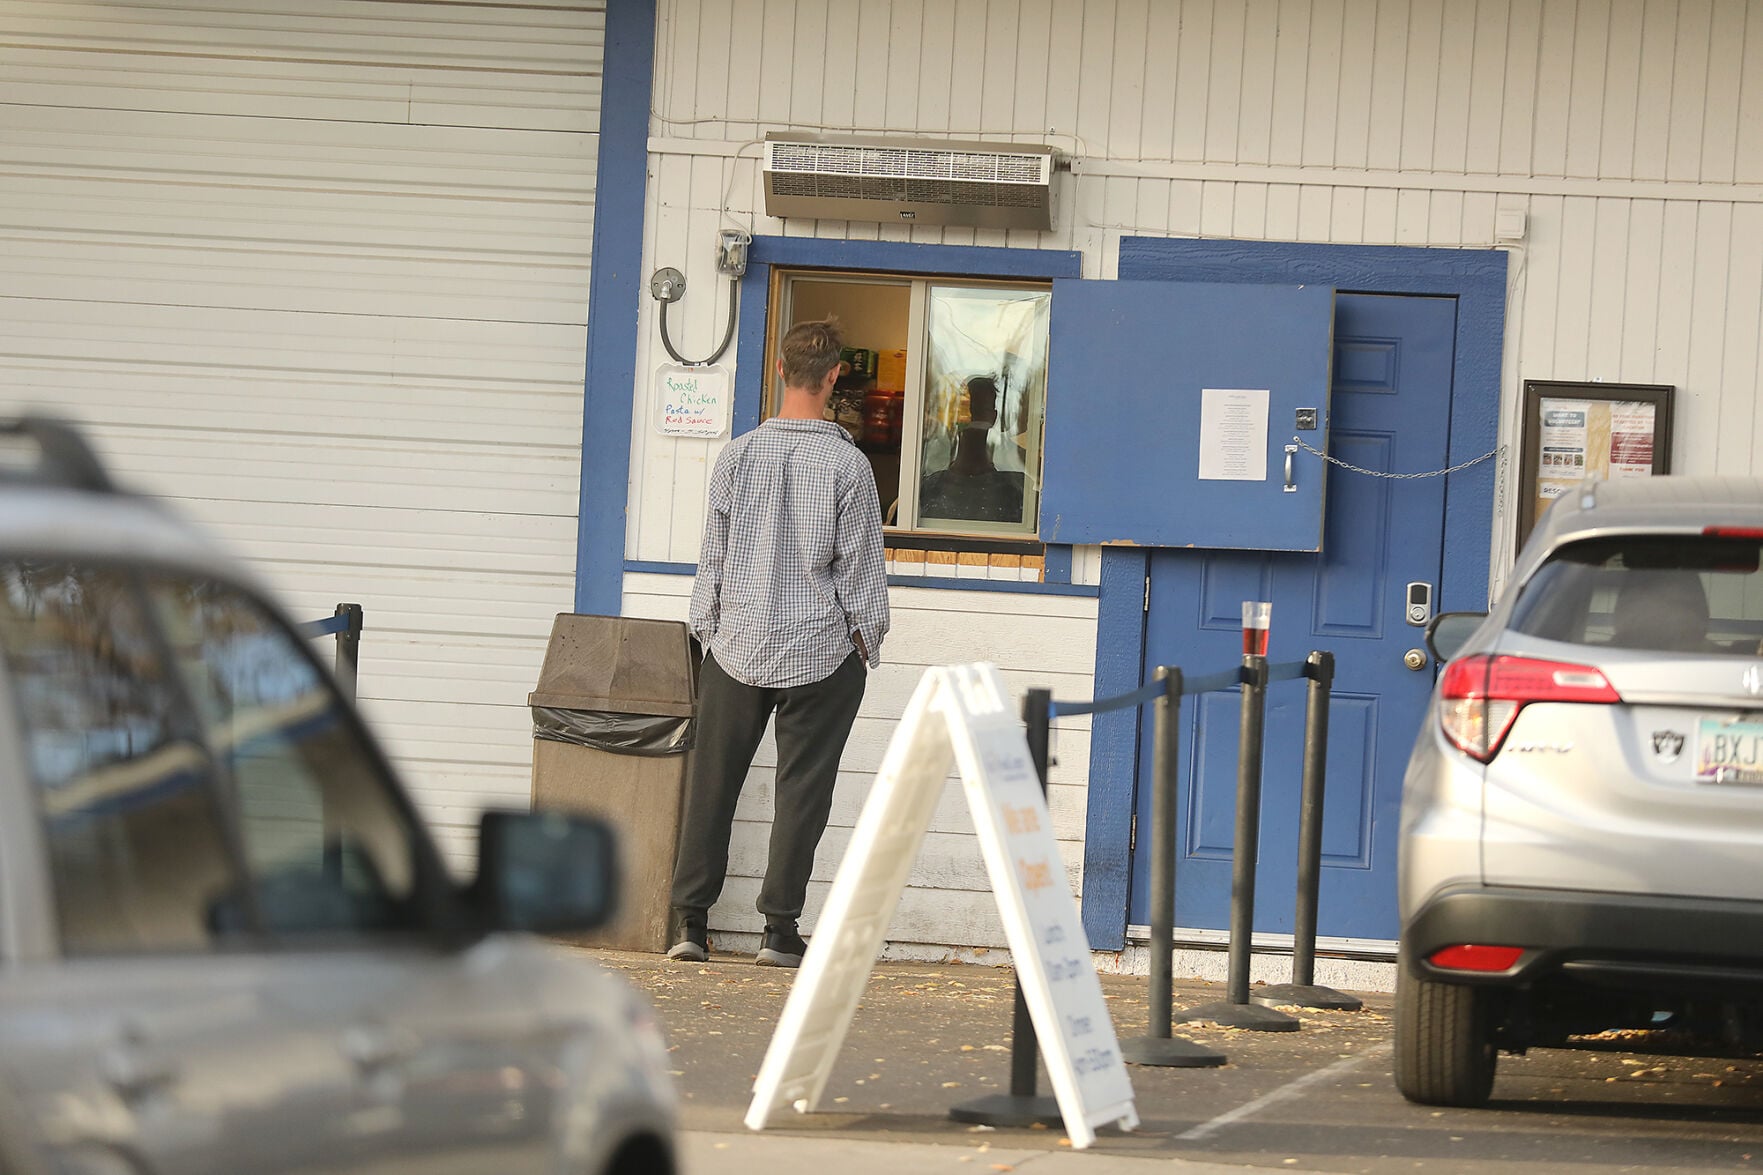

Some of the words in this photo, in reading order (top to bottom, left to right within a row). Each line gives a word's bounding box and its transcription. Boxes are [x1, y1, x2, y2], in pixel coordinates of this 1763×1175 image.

[666, 377, 698, 393] Roasted
[680, 392, 717, 405] Chicken
[665, 404, 689, 414] Pasta
[686, 416, 713, 424] Sauce
[1714, 733, 1763, 765] BXJ
